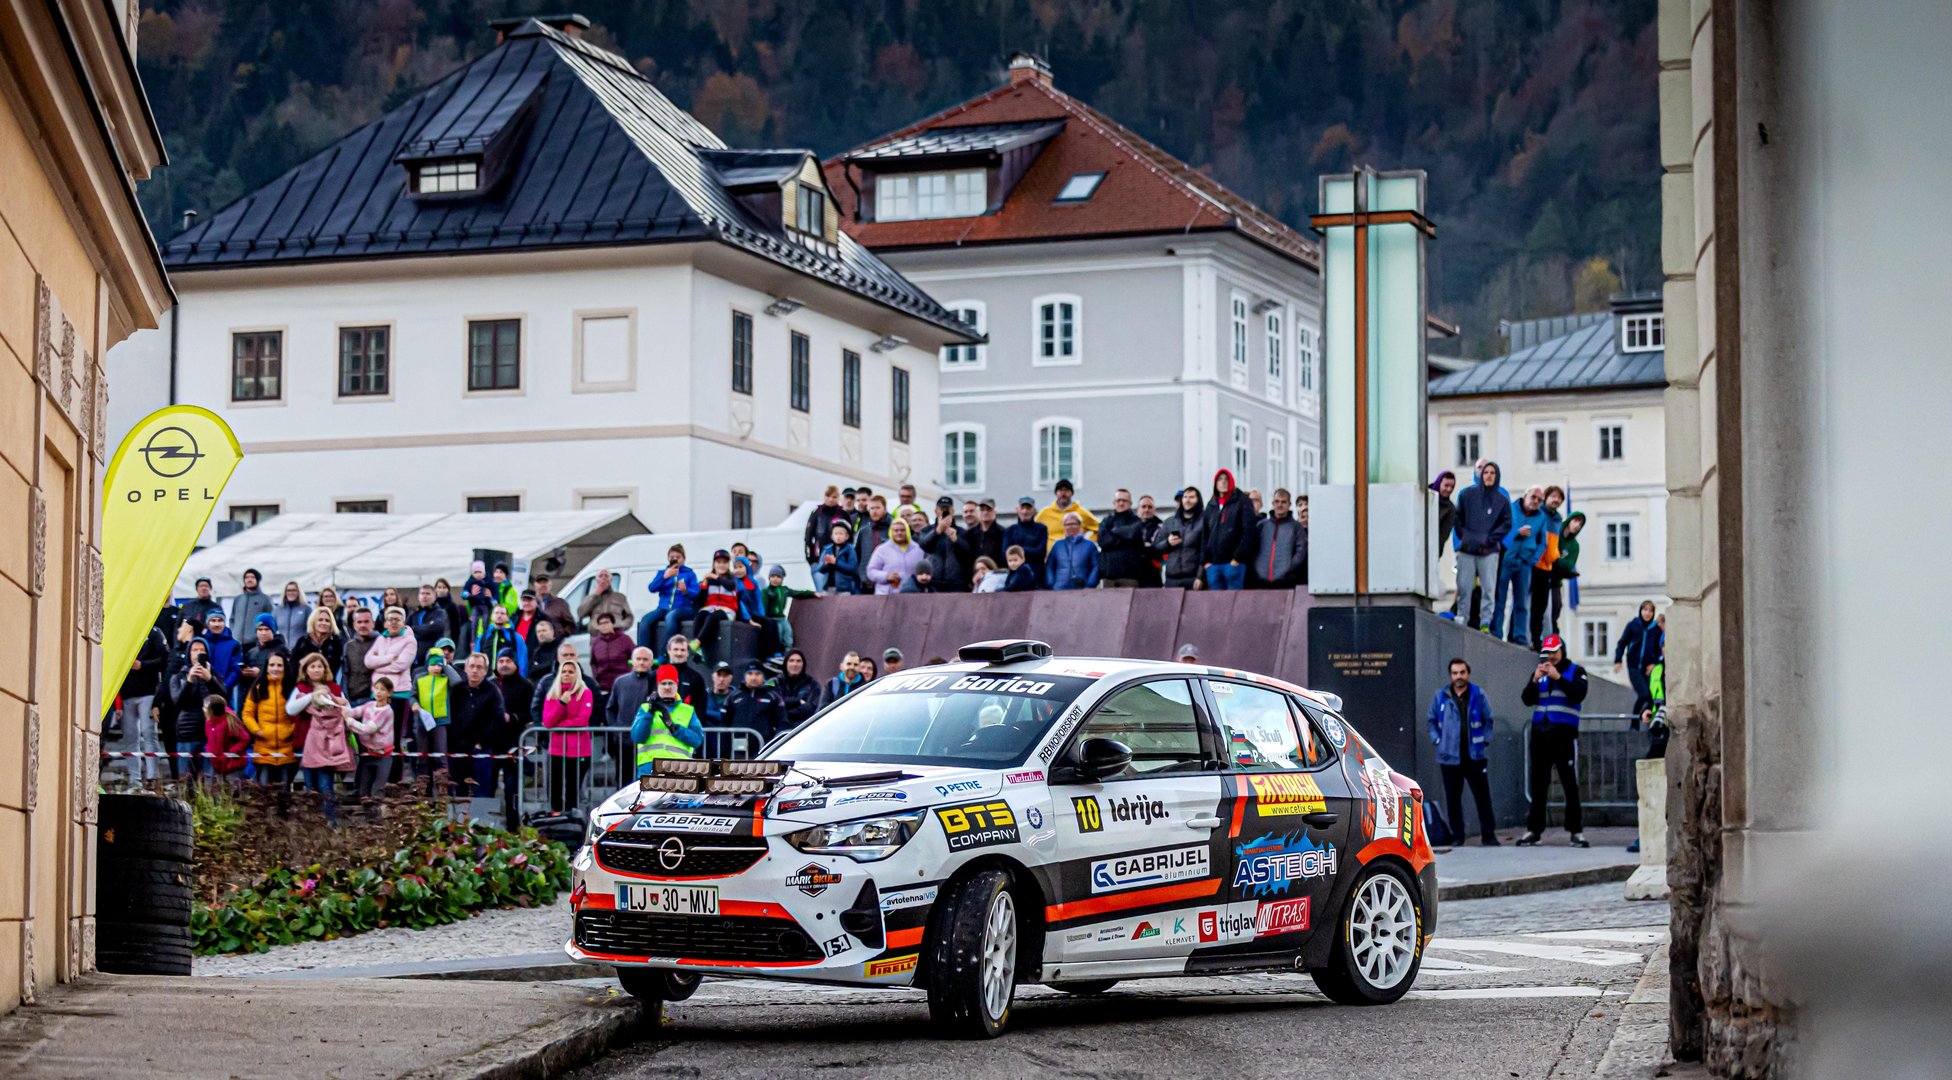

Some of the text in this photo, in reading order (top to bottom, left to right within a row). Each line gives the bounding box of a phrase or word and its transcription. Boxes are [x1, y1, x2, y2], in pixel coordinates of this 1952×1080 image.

[127, 488, 215, 503] OPEL
[949, 675, 1056, 695] Gorica
[1038, 705, 1083, 765] RBMOTORSPORT
[947, 780, 983, 793] PETRE
[1076, 798, 1100, 830] 10
[1108, 794, 1169, 825] Idrija.
[654, 816, 734, 827] GABRIJEL
[950, 828, 1016, 848] COMPANY
[1115, 849, 1207, 876] GABRIJEL
[1233, 848, 1337, 887] ASTECH
[786, 876, 811, 886] MARK
[1164, 867, 1208, 880] aluminium
[630, 886, 716, 914] LJ 30-MVJ
[1220, 913, 1256, 936] triglav
